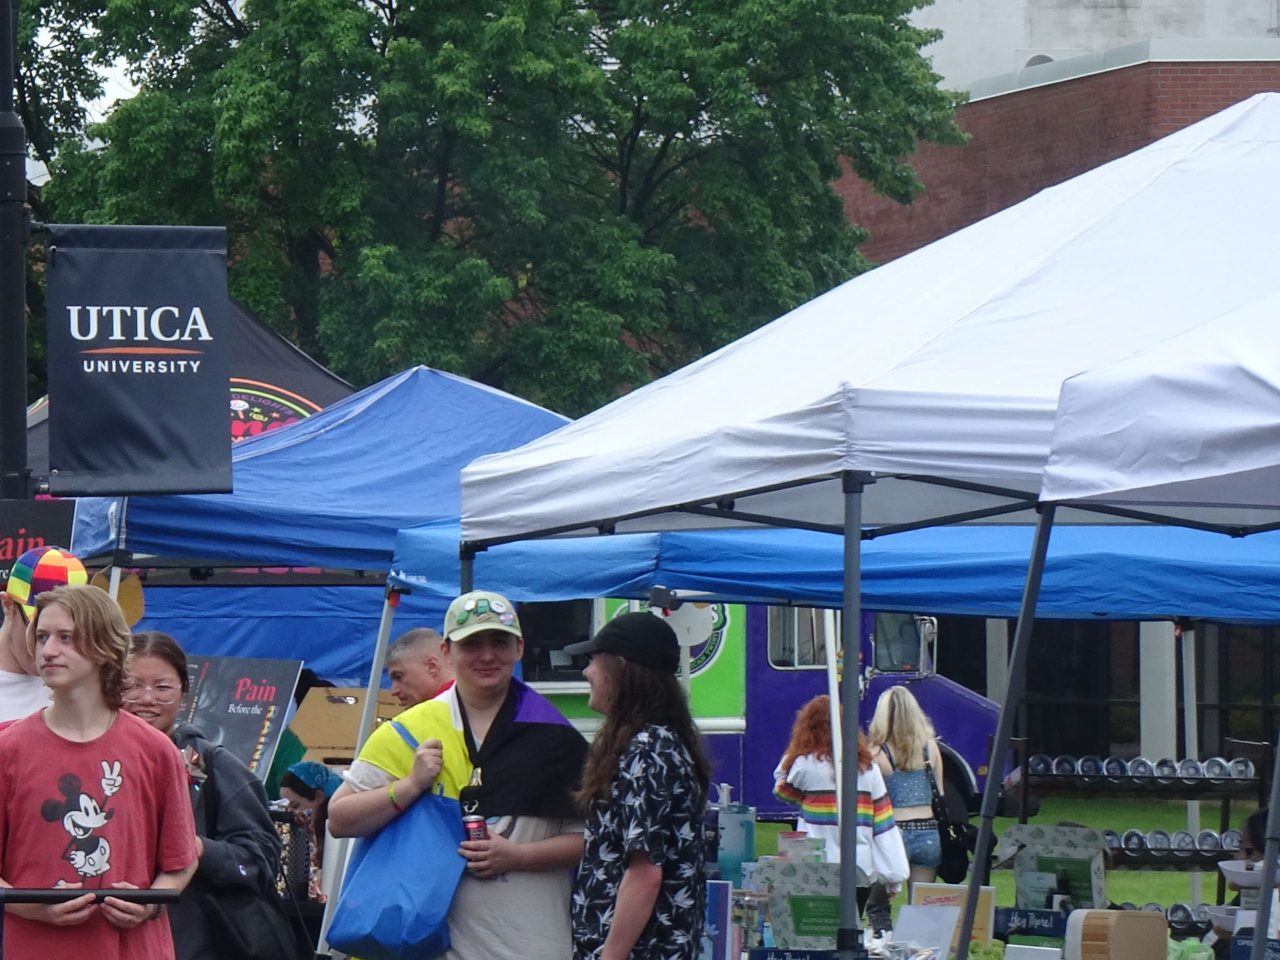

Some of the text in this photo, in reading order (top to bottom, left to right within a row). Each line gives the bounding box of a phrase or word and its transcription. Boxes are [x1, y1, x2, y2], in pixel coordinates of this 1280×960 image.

[67, 305, 213, 342] UTICA
[83, 359, 201, 374] UNIVERSITY
[234, 677, 277, 702] Pain
[227, 703, 250, 714] Before
